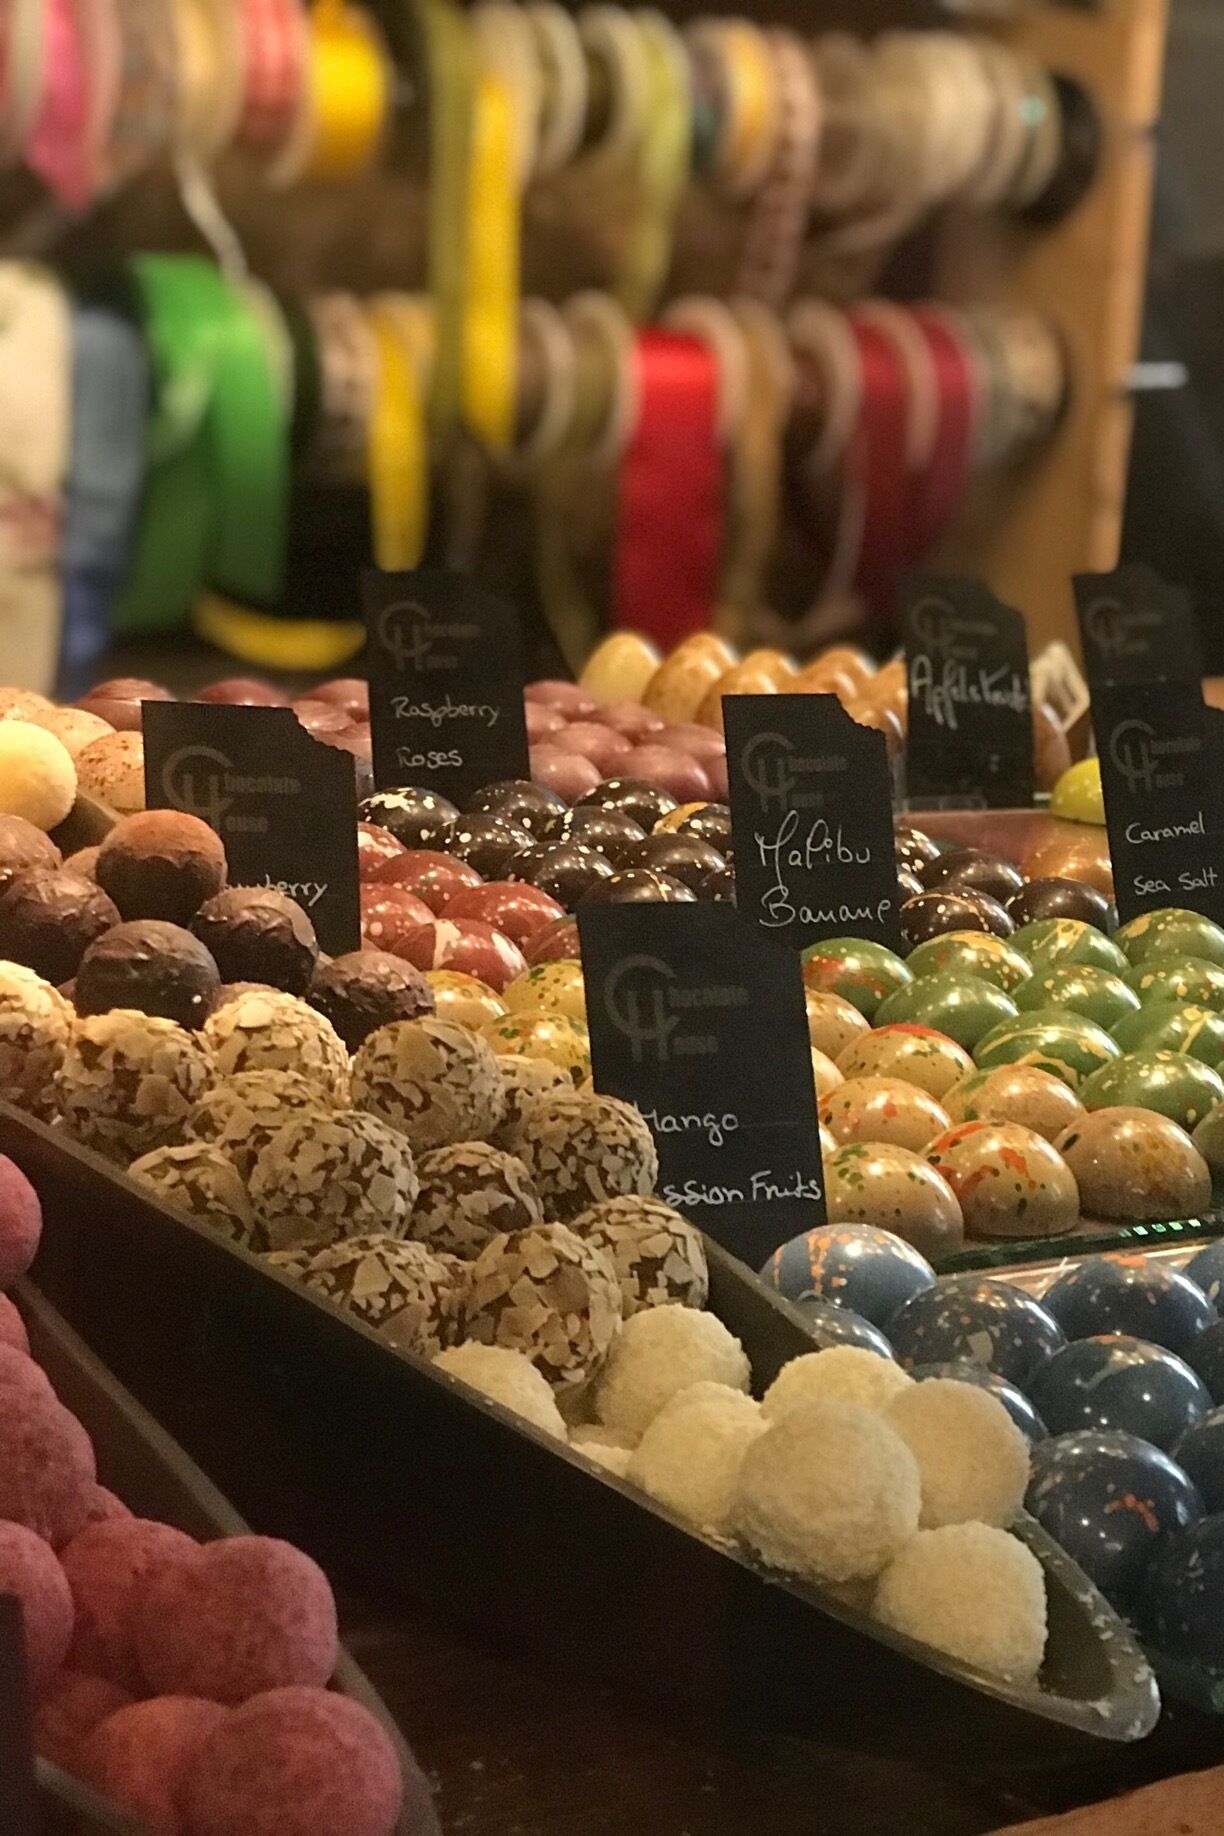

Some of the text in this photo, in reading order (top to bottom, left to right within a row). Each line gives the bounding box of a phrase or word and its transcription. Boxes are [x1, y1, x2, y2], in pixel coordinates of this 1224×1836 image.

[390, 693, 500, 728] Raspberry
[396, 746, 463, 769] Roses
[1125, 811, 1206, 844] Caramel
[754, 809, 871, 890] Malibu
[1133, 867, 1219, 896] Sea Salt
[758, 885, 892, 928] Banane
[663, 1169, 823, 1207] ssion Fruits
